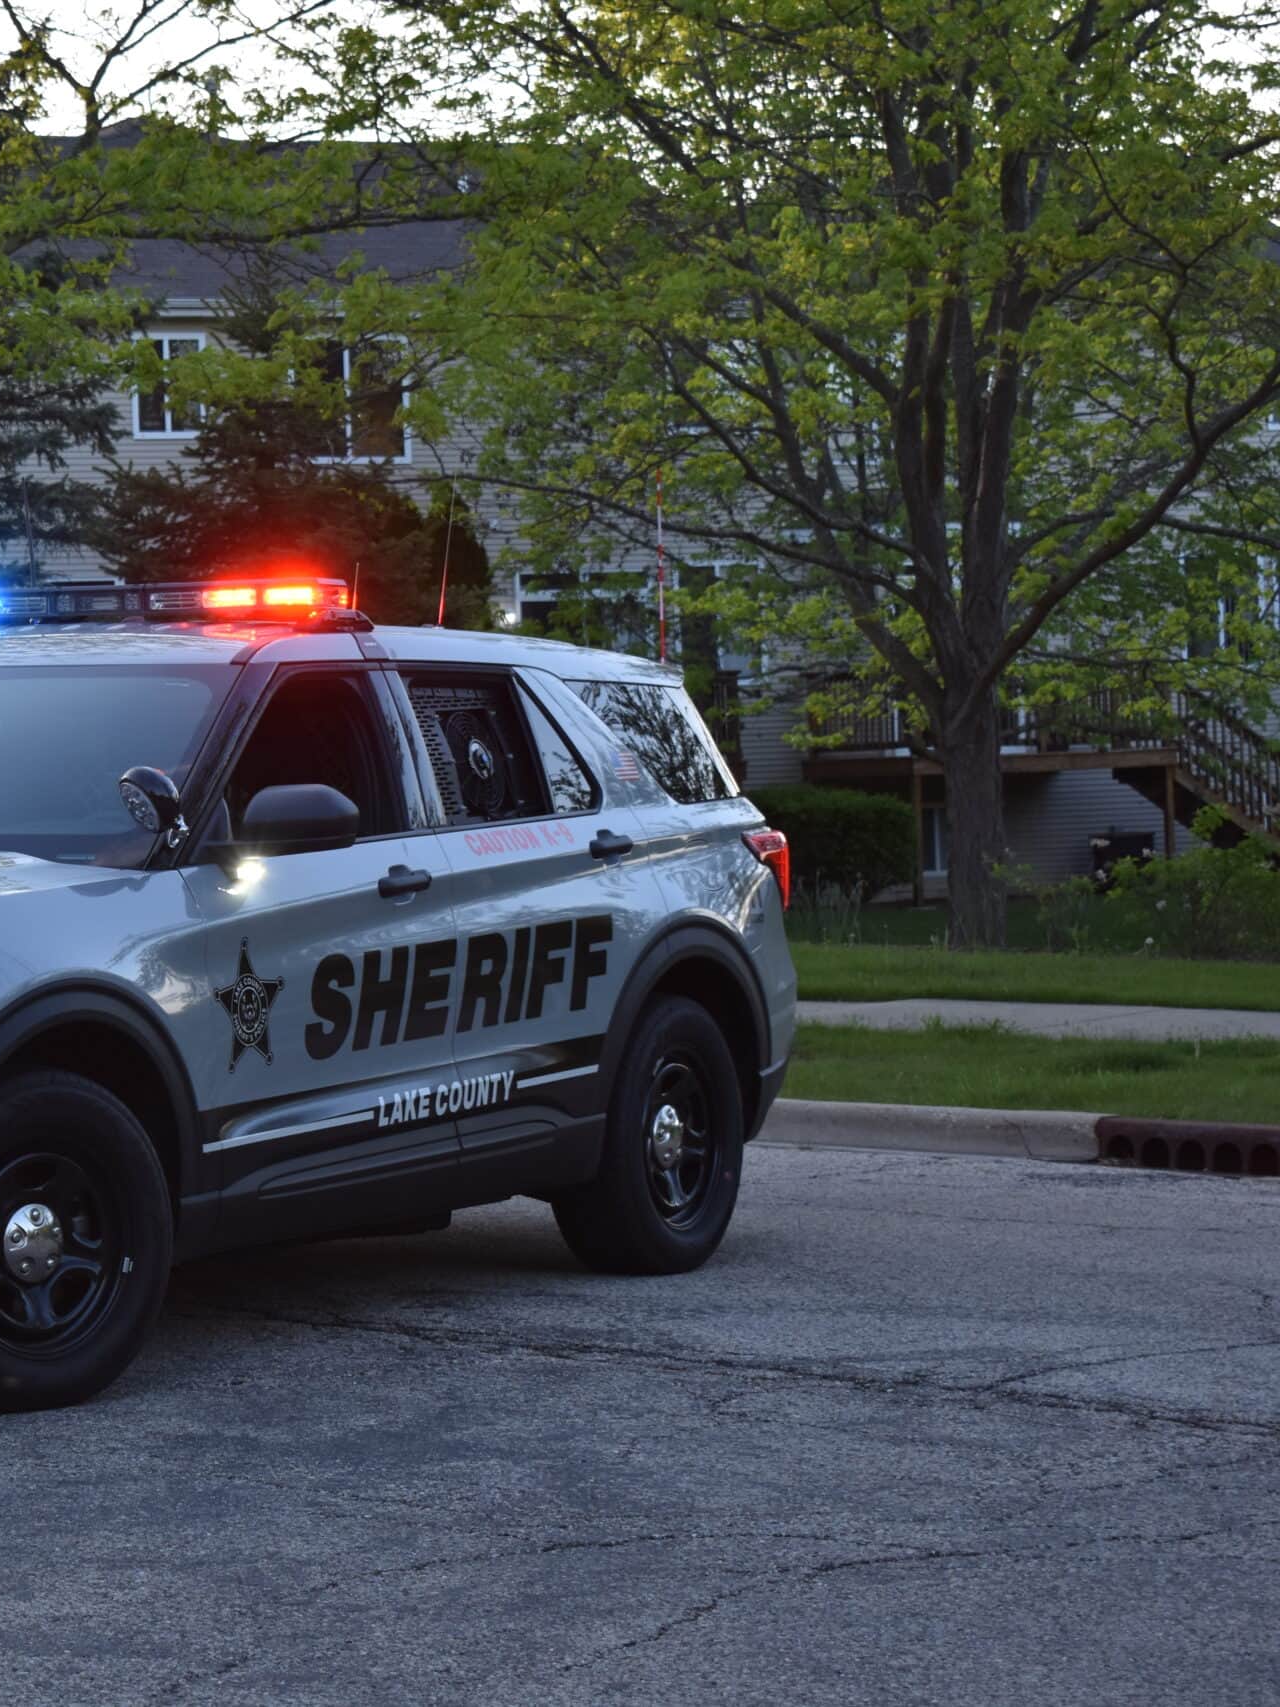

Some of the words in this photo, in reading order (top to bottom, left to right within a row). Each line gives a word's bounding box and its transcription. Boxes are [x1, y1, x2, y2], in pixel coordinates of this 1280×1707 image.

[463, 826, 541, 857] CAUTION
[538, 821, 575, 847] K-9
[304, 913, 614, 1061] SHERIFF
[377, 1087, 431, 1127] LAKE
[435, 1070, 515, 1116] COUNTY
